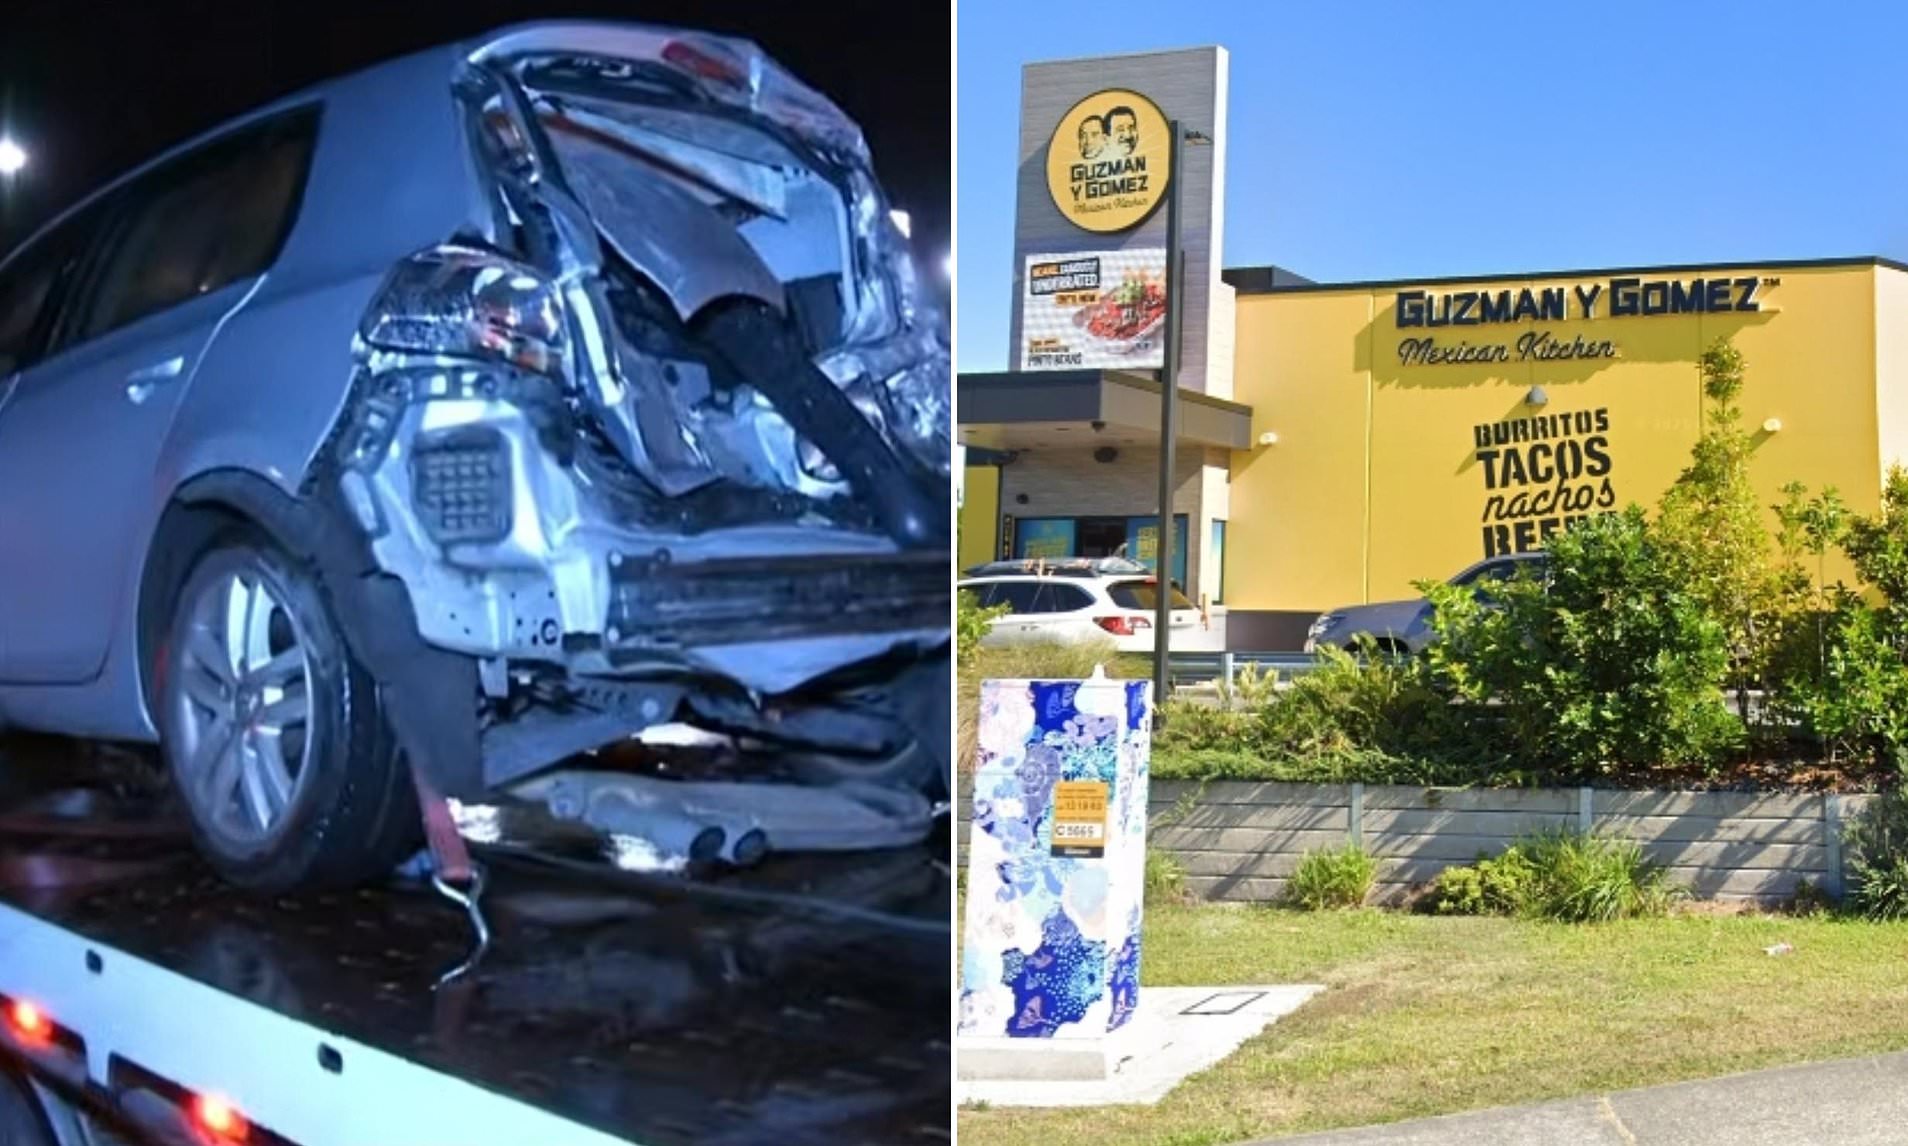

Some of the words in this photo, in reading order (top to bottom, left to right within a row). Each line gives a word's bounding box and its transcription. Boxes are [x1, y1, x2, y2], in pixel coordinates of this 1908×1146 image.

[1070, 184, 1081, 201] Y
[1086, 175, 1148, 199] GOMEZ
[1071, 156, 1146, 182] GUZMAN
[1396, 288, 1566, 328] GUZMAN
[1575, 284, 1602, 319] Y
[1610, 276, 1760, 317] GOMEZ
[1399, 337, 1509, 366] Mexican
[1517, 331, 1616, 361] Kitchen
[1474, 408, 1609, 448] BURRITOS
[1476, 436, 1612, 490] TACOS
[1482, 476, 1616, 523] nachos
